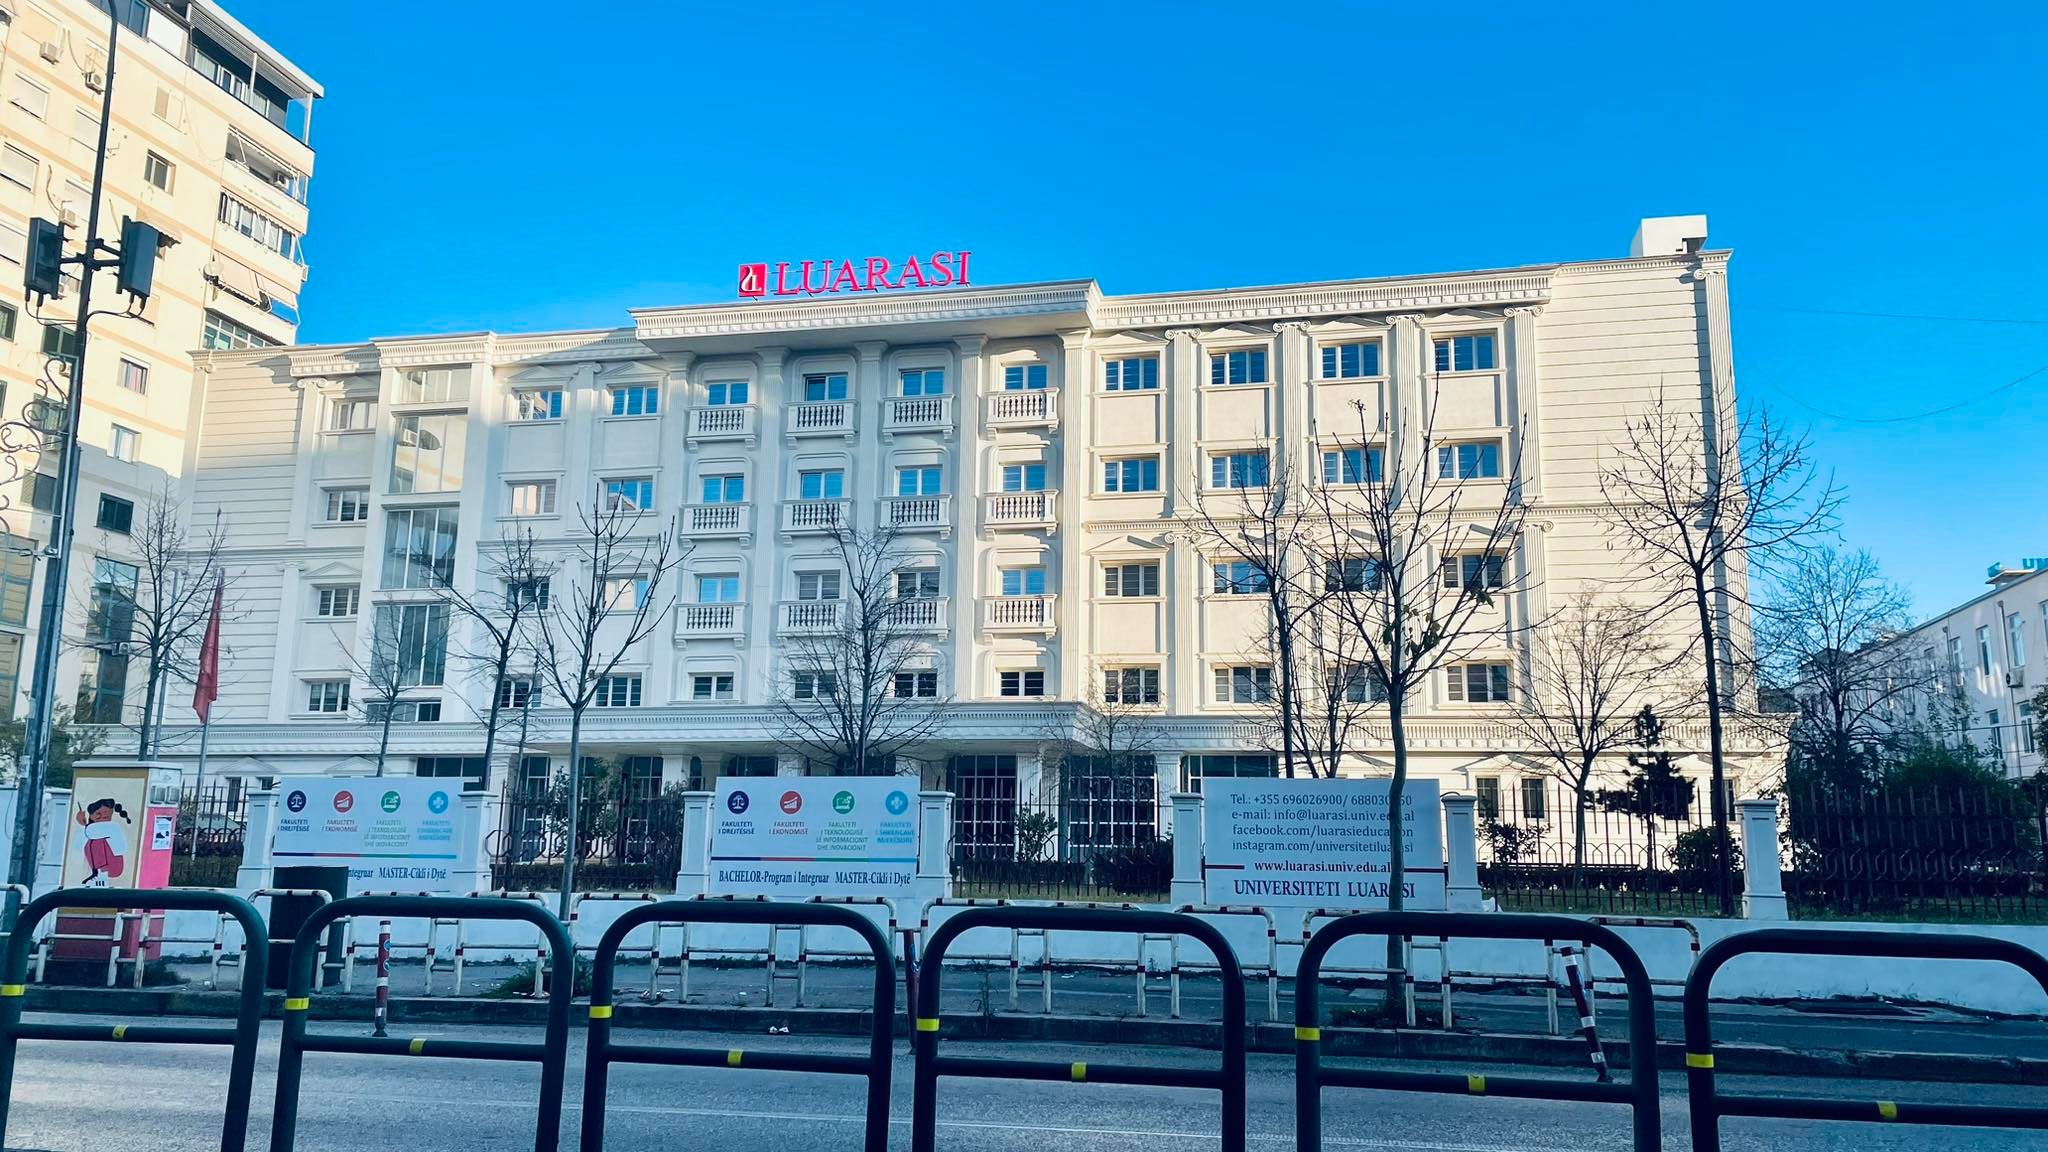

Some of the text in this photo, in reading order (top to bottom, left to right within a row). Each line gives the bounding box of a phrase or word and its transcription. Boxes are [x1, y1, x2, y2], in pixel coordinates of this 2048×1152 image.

[773, 251, 972, 296] LUARASI
[1230, 793, 1251, 805] Tel.:
[1254, 793, 1280, 805] +355
[1351, 794, 1412, 806] 68803050
[1231, 809, 1271, 820] e-mail:
[1232, 824, 1413, 838] facebook.com/luarasieducaon
[1232, 840, 1413, 854] instagram.com/universitetiluasi
[1254, 860, 1391, 873] www.luarasi.univ.edu.al
[348, 868, 374, 880] ntegruar
[718, 870, 793, 886] BACHELOR-Program
[798, 872, 829, 887] Integruar
[834, 871, 888, 884] MASTER-Cikli
[894, 872, 911, 887] Dytë
[1234, 879, 1416, 898] UNIVERSITETI LUARSI
